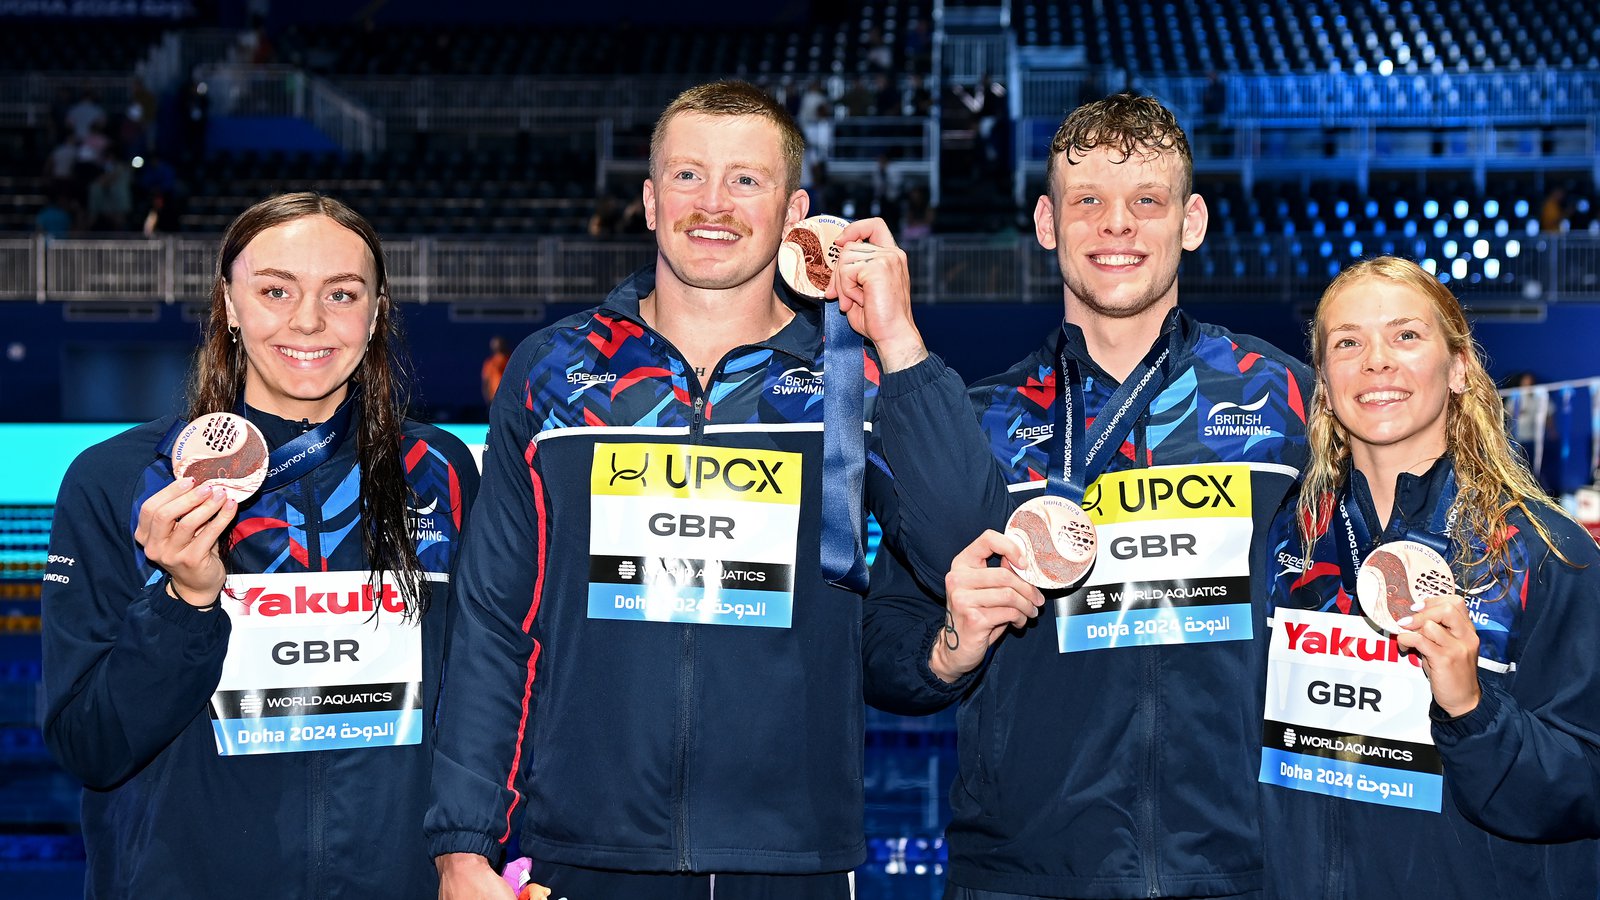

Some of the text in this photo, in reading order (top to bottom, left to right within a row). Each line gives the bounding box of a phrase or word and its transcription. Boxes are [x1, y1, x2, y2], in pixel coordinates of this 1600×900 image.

[566, 371, 617, 385] speedo
[785, 375, 825, 387] BRITIS
[1100, 383, 1143, 440] CHAMPIONSHIPS
[1140, 365, 1157, 387] DOHA
[1155, 347, 1170, 369] 2024
[1203, 425, 1271, 436] SWIMMING
[1215, 414, 1262, 425] BRITISH
[665, 454, 784, 494] UPCX
[1118, 474, 1236, 513] UPCX
[648, 512, 736, 540] GBR
[1343, 518, 1357, 549] DOHA
[1109, 533, 1198, 560] GBR
[47, 554, 76, 567] sport
[223, 583, 405, 617] Yakult
[1164, 585, 1228, 600] AQUATICS
[1086, 618, 1180, 639] Doha 2024
[1184, 615, 1231, 637] الدوحة
[271, 638, 360, 666] GBR
[266, 691, 393, 709] WORLD AQUATICS
[1307, 680, 1382, 713] GBR
[237, 724, 337, 745] Doha 2024
[340, 722, 395, 743] الدوحة
[1300, 734, 1414, 763] WORLD AQUATICS
[1280, 761, 1354, 789] Doha 2024
[1356, 774, 1414, 800] الدوحة
